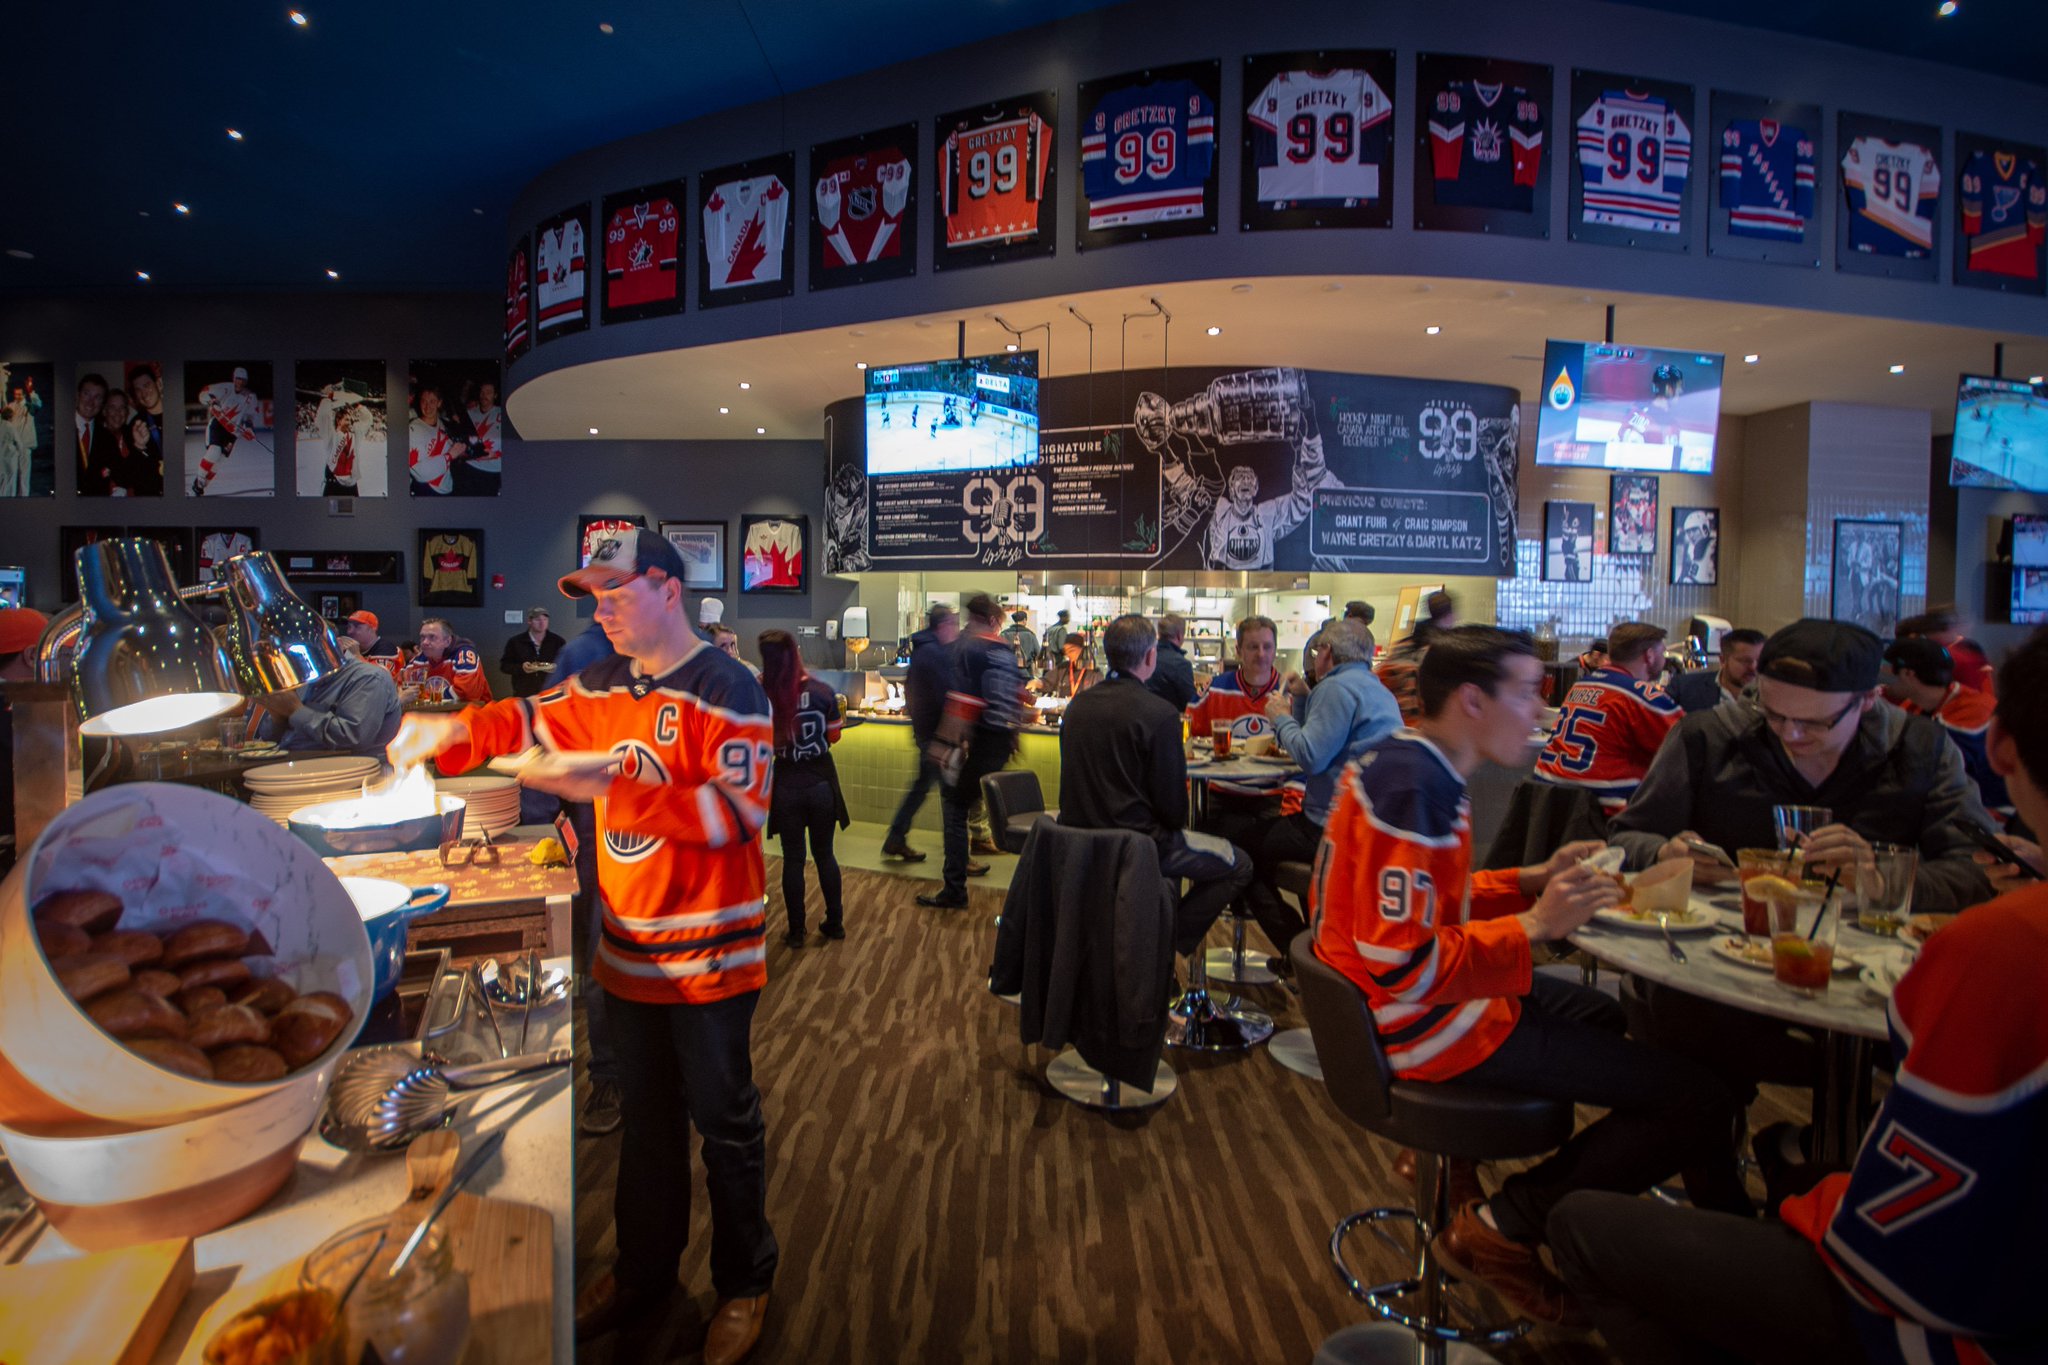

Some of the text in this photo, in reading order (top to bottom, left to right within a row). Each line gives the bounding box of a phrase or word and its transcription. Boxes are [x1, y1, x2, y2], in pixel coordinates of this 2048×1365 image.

[1297, 90, 1347, 111] GRETZKY
[1113, 104, 1177, 135] GRETZKY
[1611, 114, 1659, 135] GRETZKY
[967, 127, 1017, 150] GRETZKY
[1286, 112, 1353, 164] 99
[1114, 126, 1177, 186] 99
[1607, 131, 1660, 185] 99
[968, 143, 1018, 200] 99
[1873, 167, 1911, 214] 99
[609, 227, 626, 244] 99
[659, 216, 677, 234] 99
[727, 219, 752, 265] CANADA
[985, 378, 1008, 389] DELTA
[1339, 411, 1404, 426] HOCKEY NIGHT IN
[1343, 434, 1379, 448] DECEMBER
[1418, 407, 1478, 462] 99
[1038, 453, 1079, 465] DISHES
[1039, 441, 1102, 455] SIGNATURE
[962, 476, 1045, 543] 99
[1319, 493, 1376, 509] PREVIOUS
[1335, 514, 1469, 533] GRANT FUHR CRAIG SIMPSON
[1321, 530, 1483, 551] WAYNE GRETZKY & DARYL KATZ
[457, 649, 476, 665] 19
[1568, 688, 1604, 706] NURSE
[655, 702, 680, 745] C
[1540, 704, 1608, 774] 25
[717, 738, 773, 799] 97
[1377, 865, 1437, 929] 97
[1856, 1120, 1980, 1238] 7
